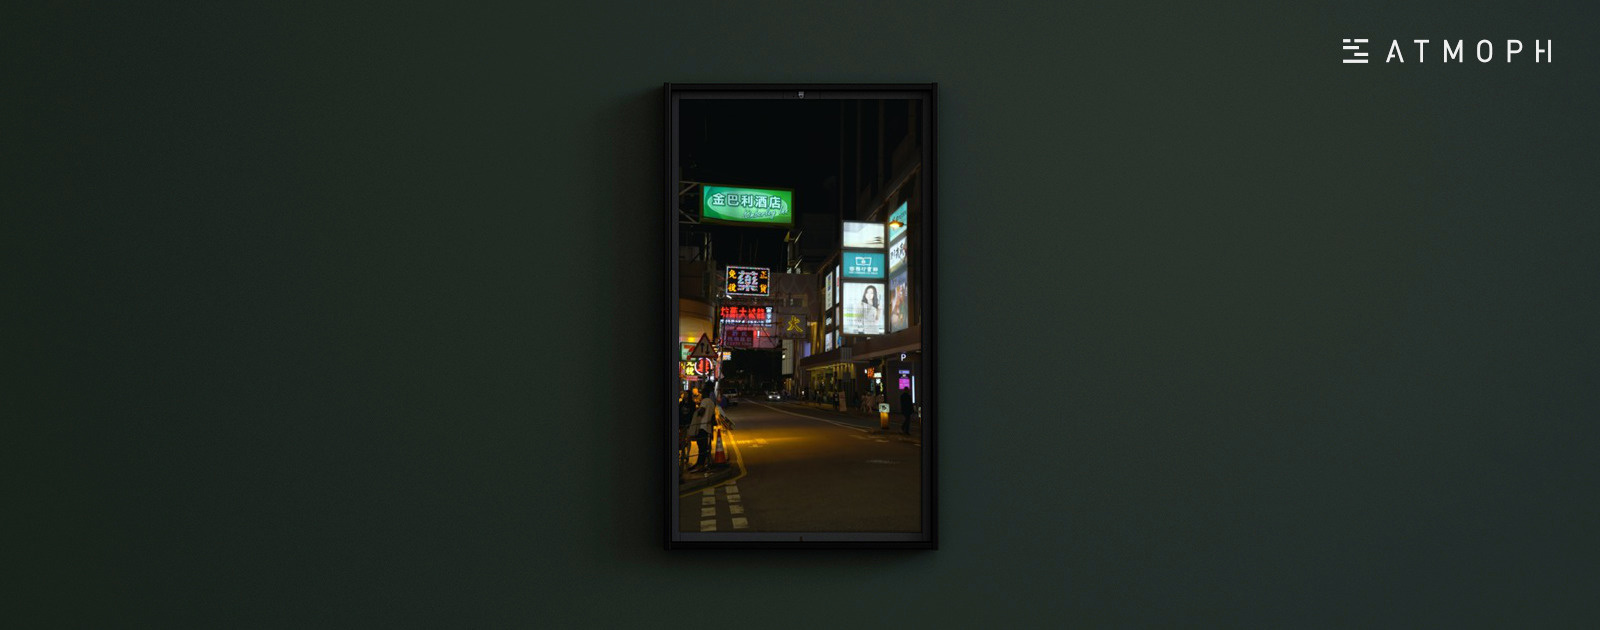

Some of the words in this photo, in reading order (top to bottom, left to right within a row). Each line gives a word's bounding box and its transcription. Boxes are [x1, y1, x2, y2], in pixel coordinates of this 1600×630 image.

[712, 193, 781, 209] 金巴利酒店
[900, 353, 907, 361] P
